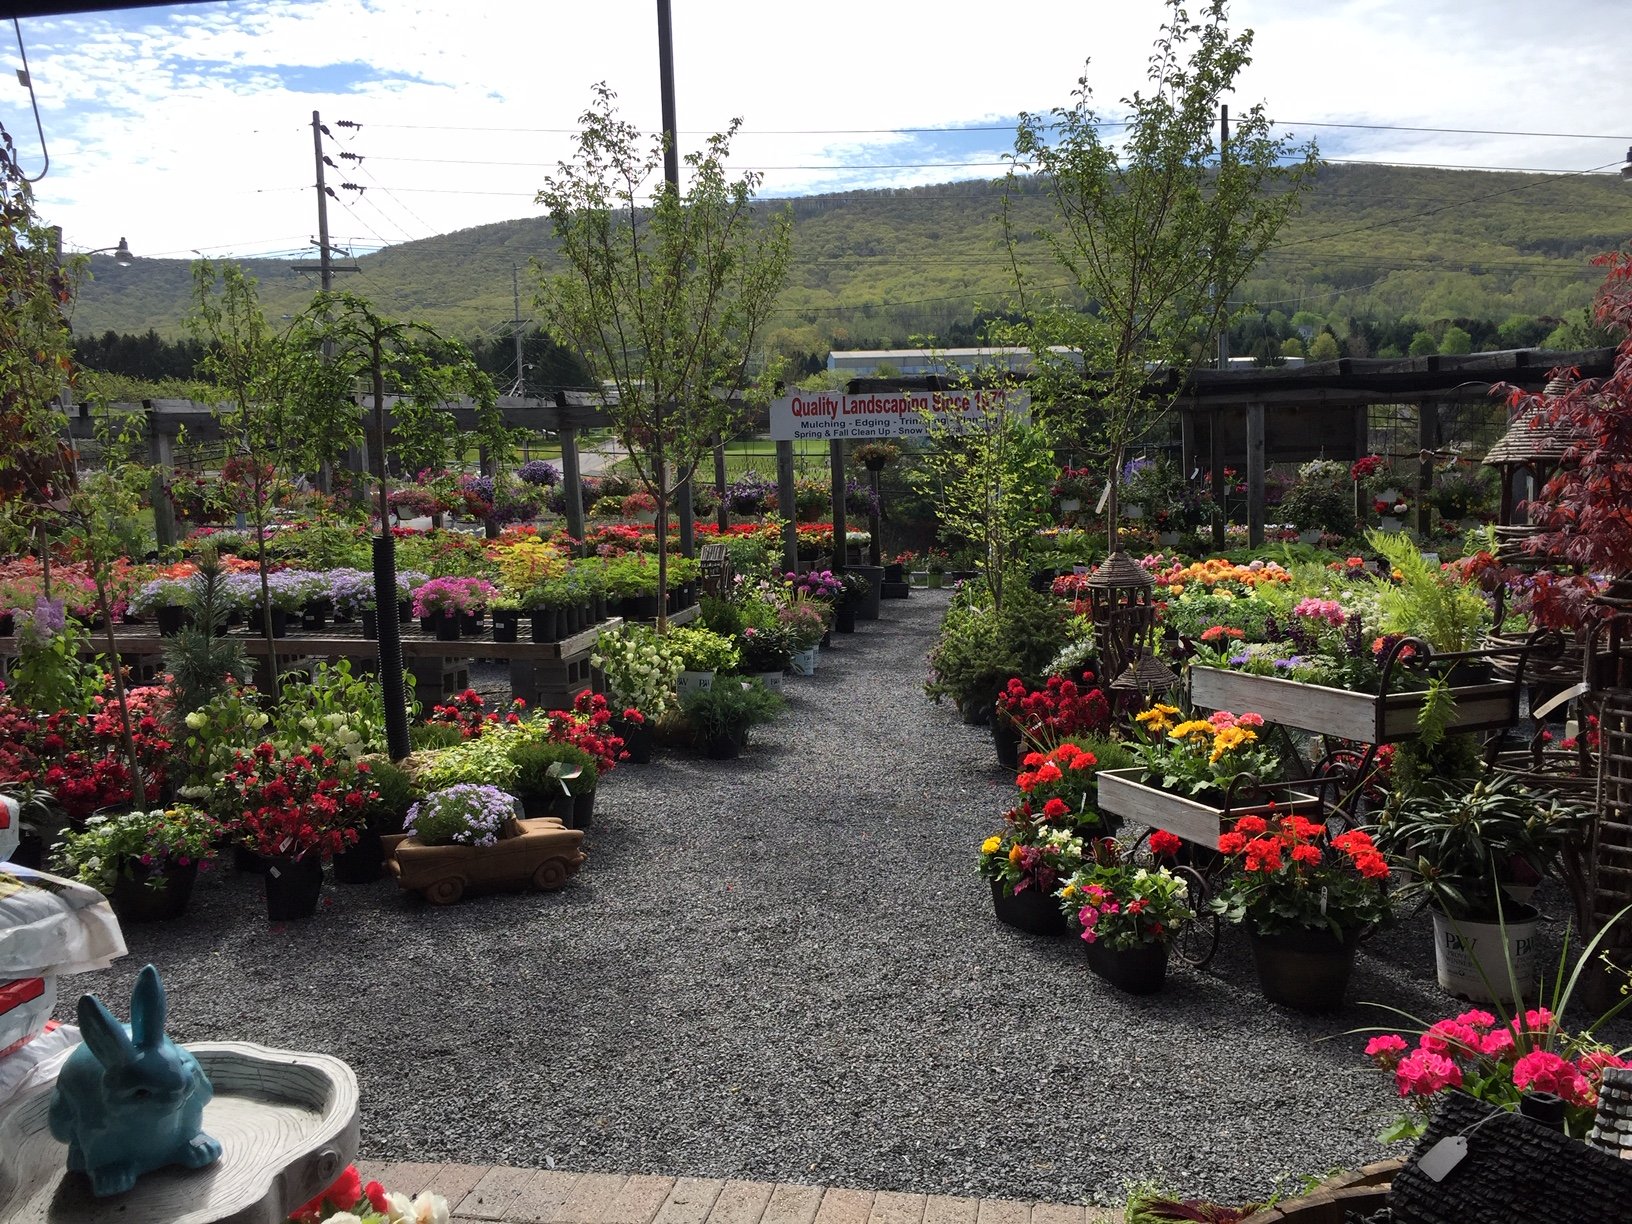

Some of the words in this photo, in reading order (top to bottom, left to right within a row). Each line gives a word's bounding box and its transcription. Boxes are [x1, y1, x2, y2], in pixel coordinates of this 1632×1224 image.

[791, 396, 838, 420] Quality
[842, 394, 928, 417] Landscaping
[932, 391, 970, 412] Since
[801, 420, 846, 429] Mulching
[855, 418, 890, 428] Edging
[794, 429, 822, 439] Spring
[824, 429, 831, 437] &
[833, 428, 849, 437] Fall
[851, 427, 876, 436] Clean
[878, 427, 891, 437] Up
[898, 426, 923, 435] Snow
